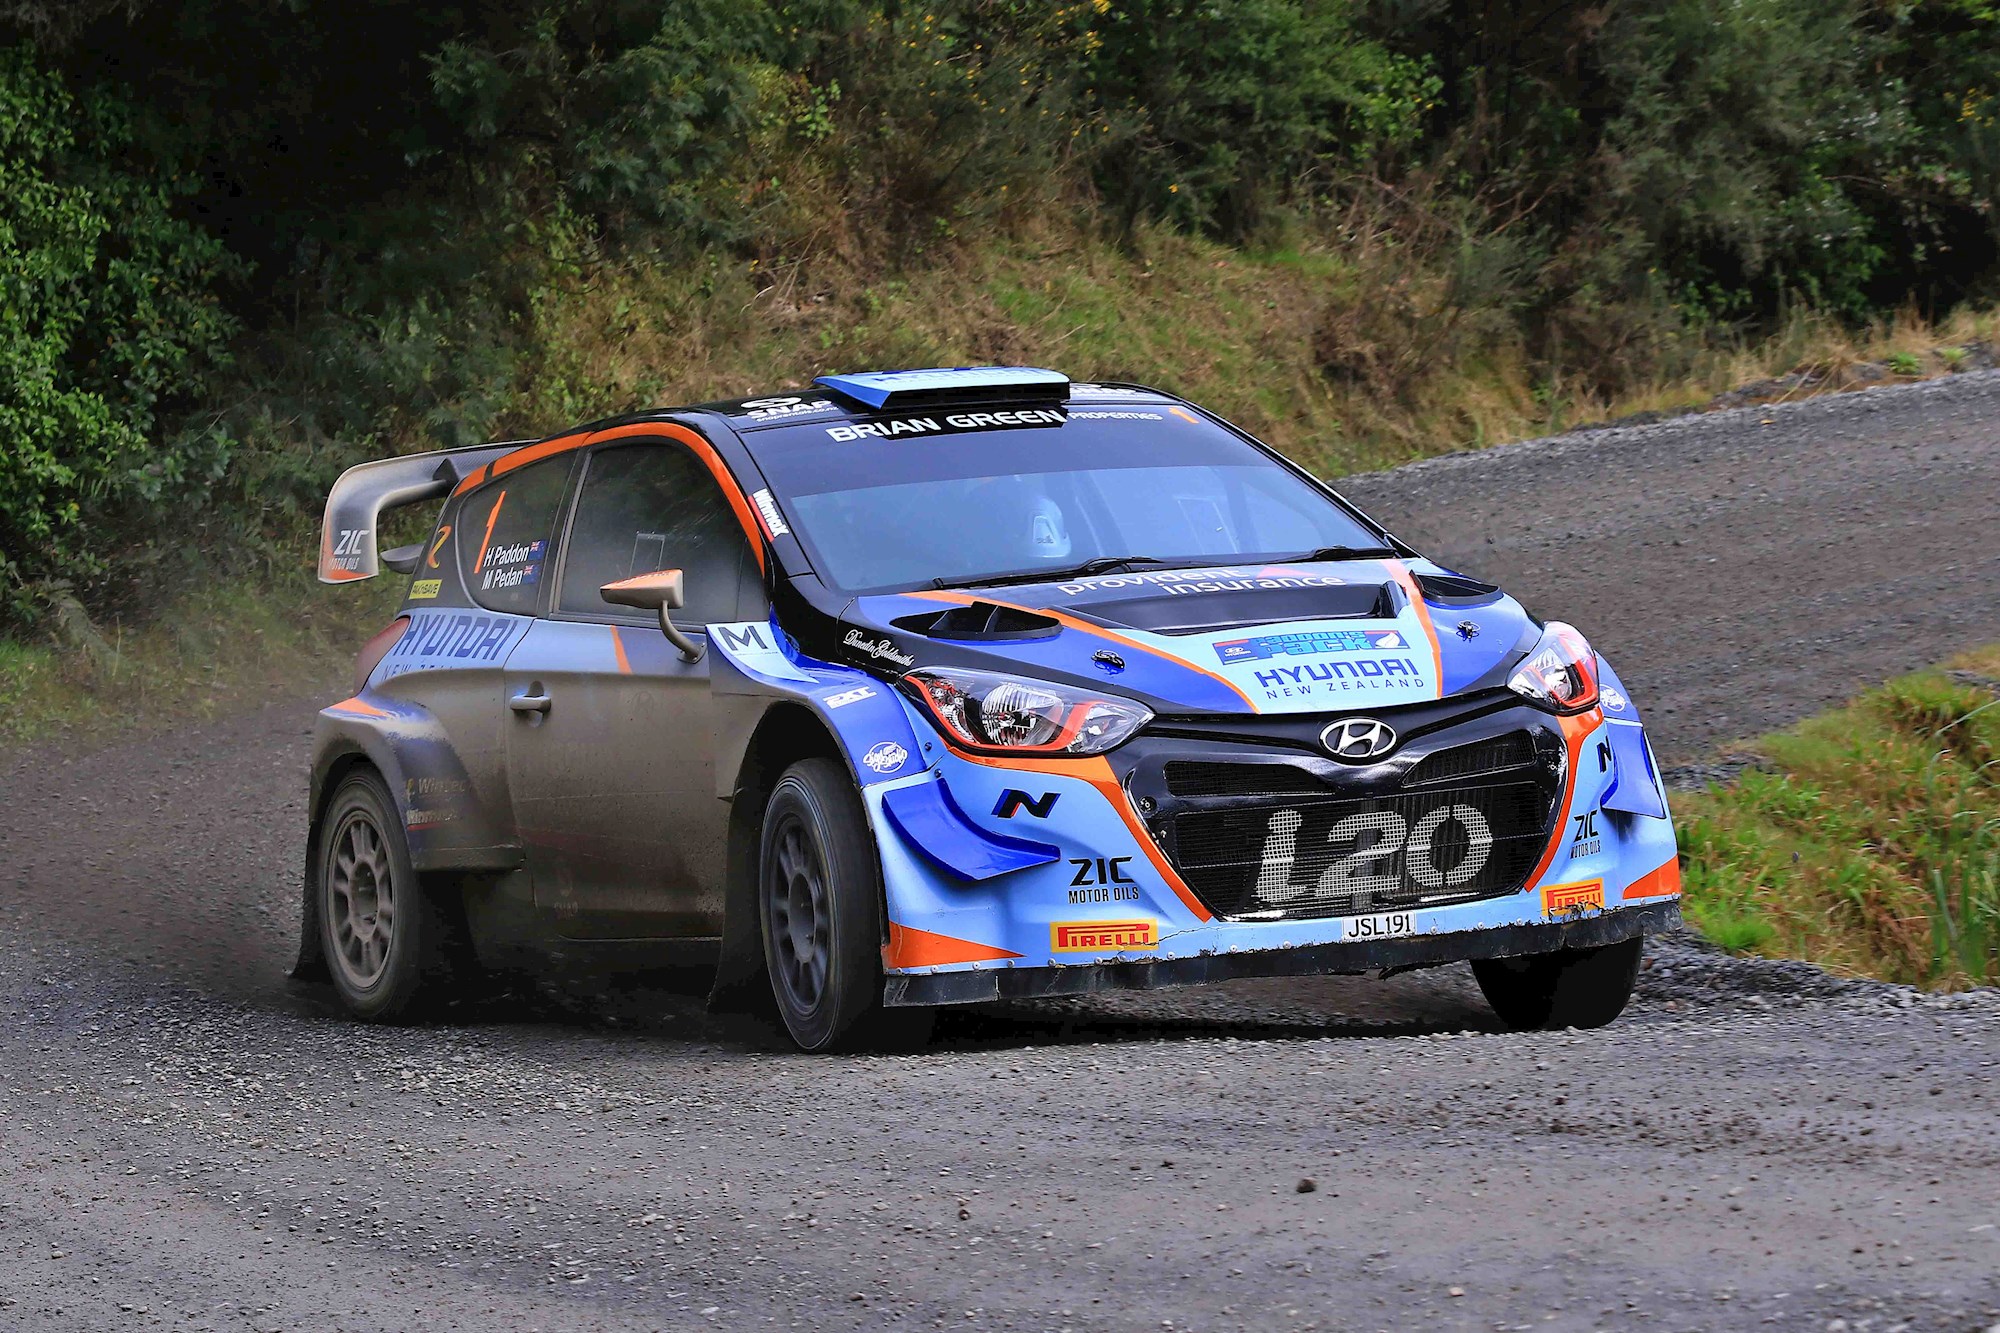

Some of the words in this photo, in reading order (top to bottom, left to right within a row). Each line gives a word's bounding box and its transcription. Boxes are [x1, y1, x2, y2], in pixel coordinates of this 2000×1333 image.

[747, 400, 832, 420] SNAP
[1067, 411, 1163, 421] PROPERTIES
[825, 417, 942, 442] BRIAN
[945, 409, 1068, 428] GREEN
[752, 488, 790, 538] Winmax
[333, 530, 370, 555] ZIC
[473, 490, 507, 574] 1
[483, 546, 495, 568] H
[492, 542, 530, 566] Paddon
[481, 569, 494, 590] M
[492, 566, 523, 589] Pedan
[1057, 569, 1250, 596] provident
[1157, 576, 1347, 595] insurance
[392, 614, 519, 661] HYUNDAI
[717, 625, 769, 651] M
[843, 629, 876, 653] Dunedin
[1253, 659, 1420, 687] HYUNDAI
[1267, 686, 1312, 699] NEW
[1326, 678, 1424, 691] ZEALAND
[991, 788, 1062, 819] N
[1573, 809, 1599, 842] ZIC
[1068, 856, 1137, 887] ZIC
[1068, 888, 1110, 904] MOTOR
[1113, 886, 1139, 901] OILS
[1057, 923, 1150, 947] PIRELLI
[1348, 912, 1413, 938] JSL191
